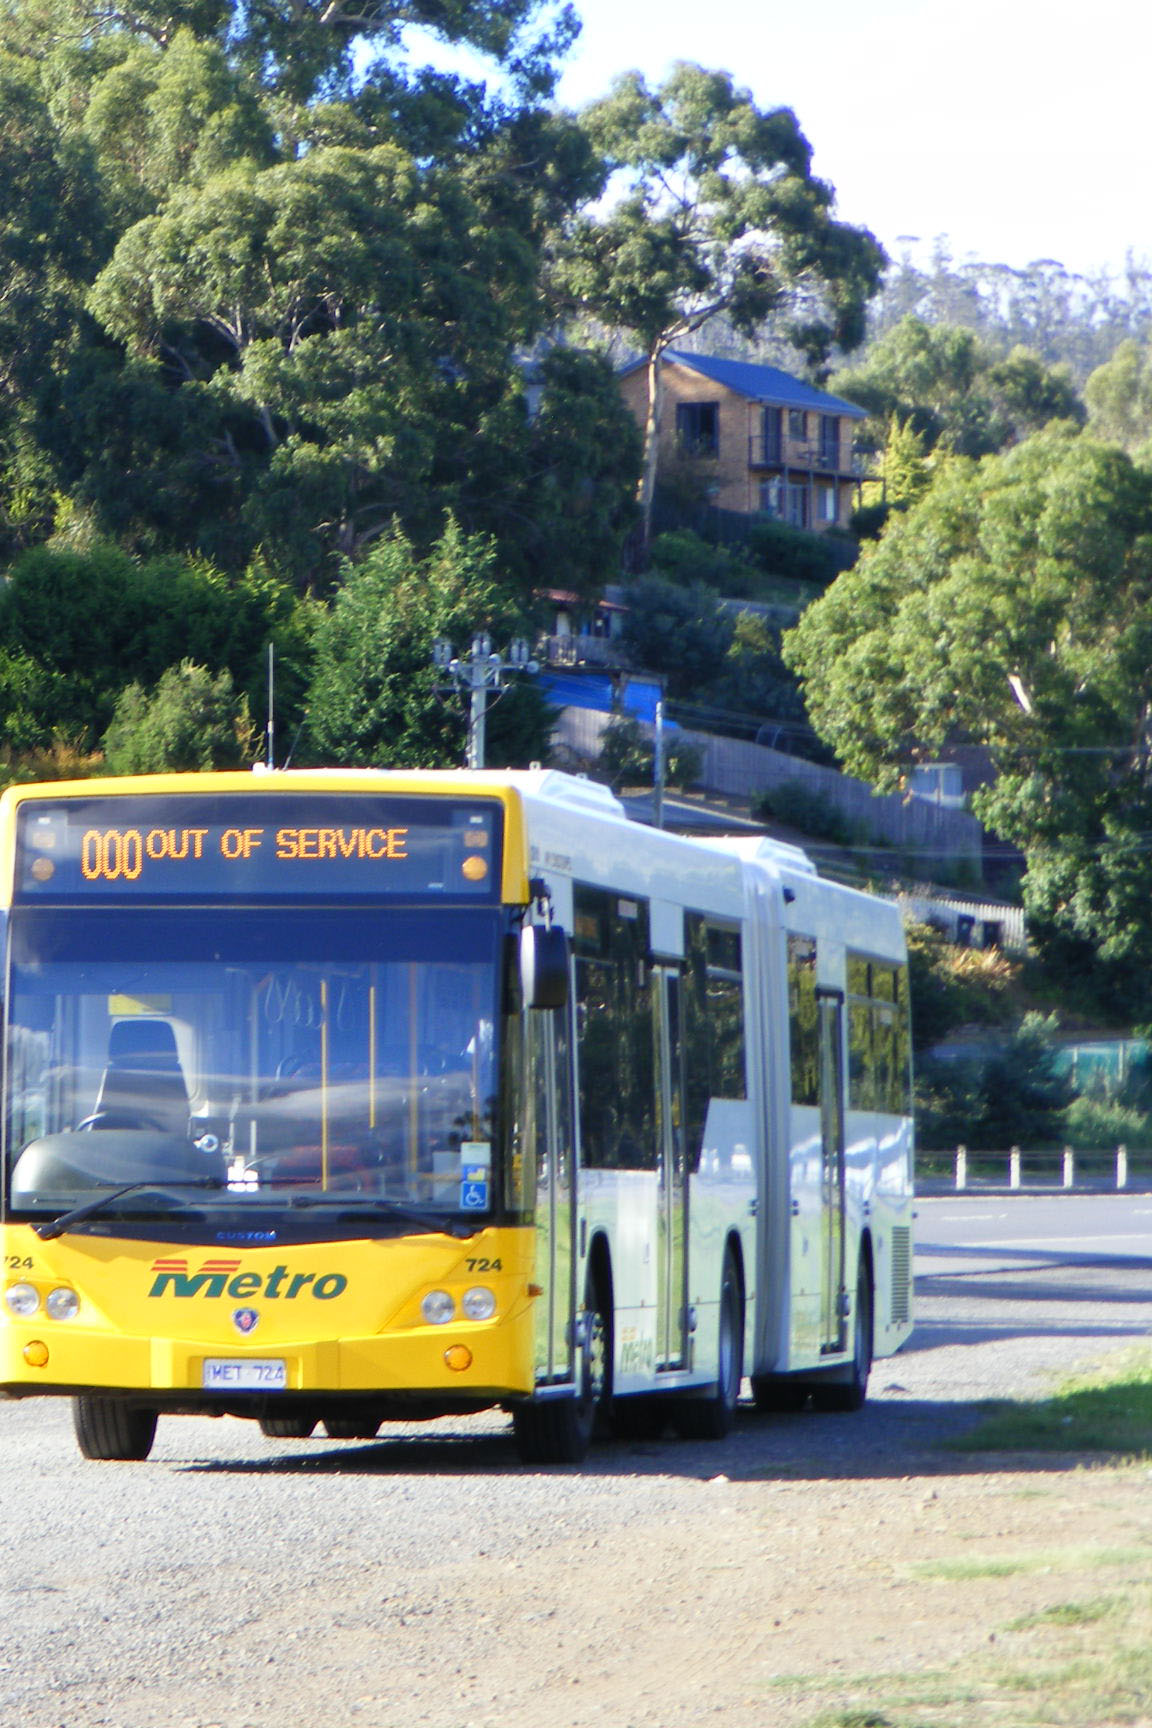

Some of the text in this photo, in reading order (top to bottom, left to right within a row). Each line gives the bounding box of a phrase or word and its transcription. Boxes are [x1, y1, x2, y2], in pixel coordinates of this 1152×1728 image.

[82, 828, 409, 880] 000 OUT OF SERVICE
[148, 1259, 348, 1300] Metro
[464, 1258, 503, 1272] 724
[211, 1364, 285, 1381] MET 724
